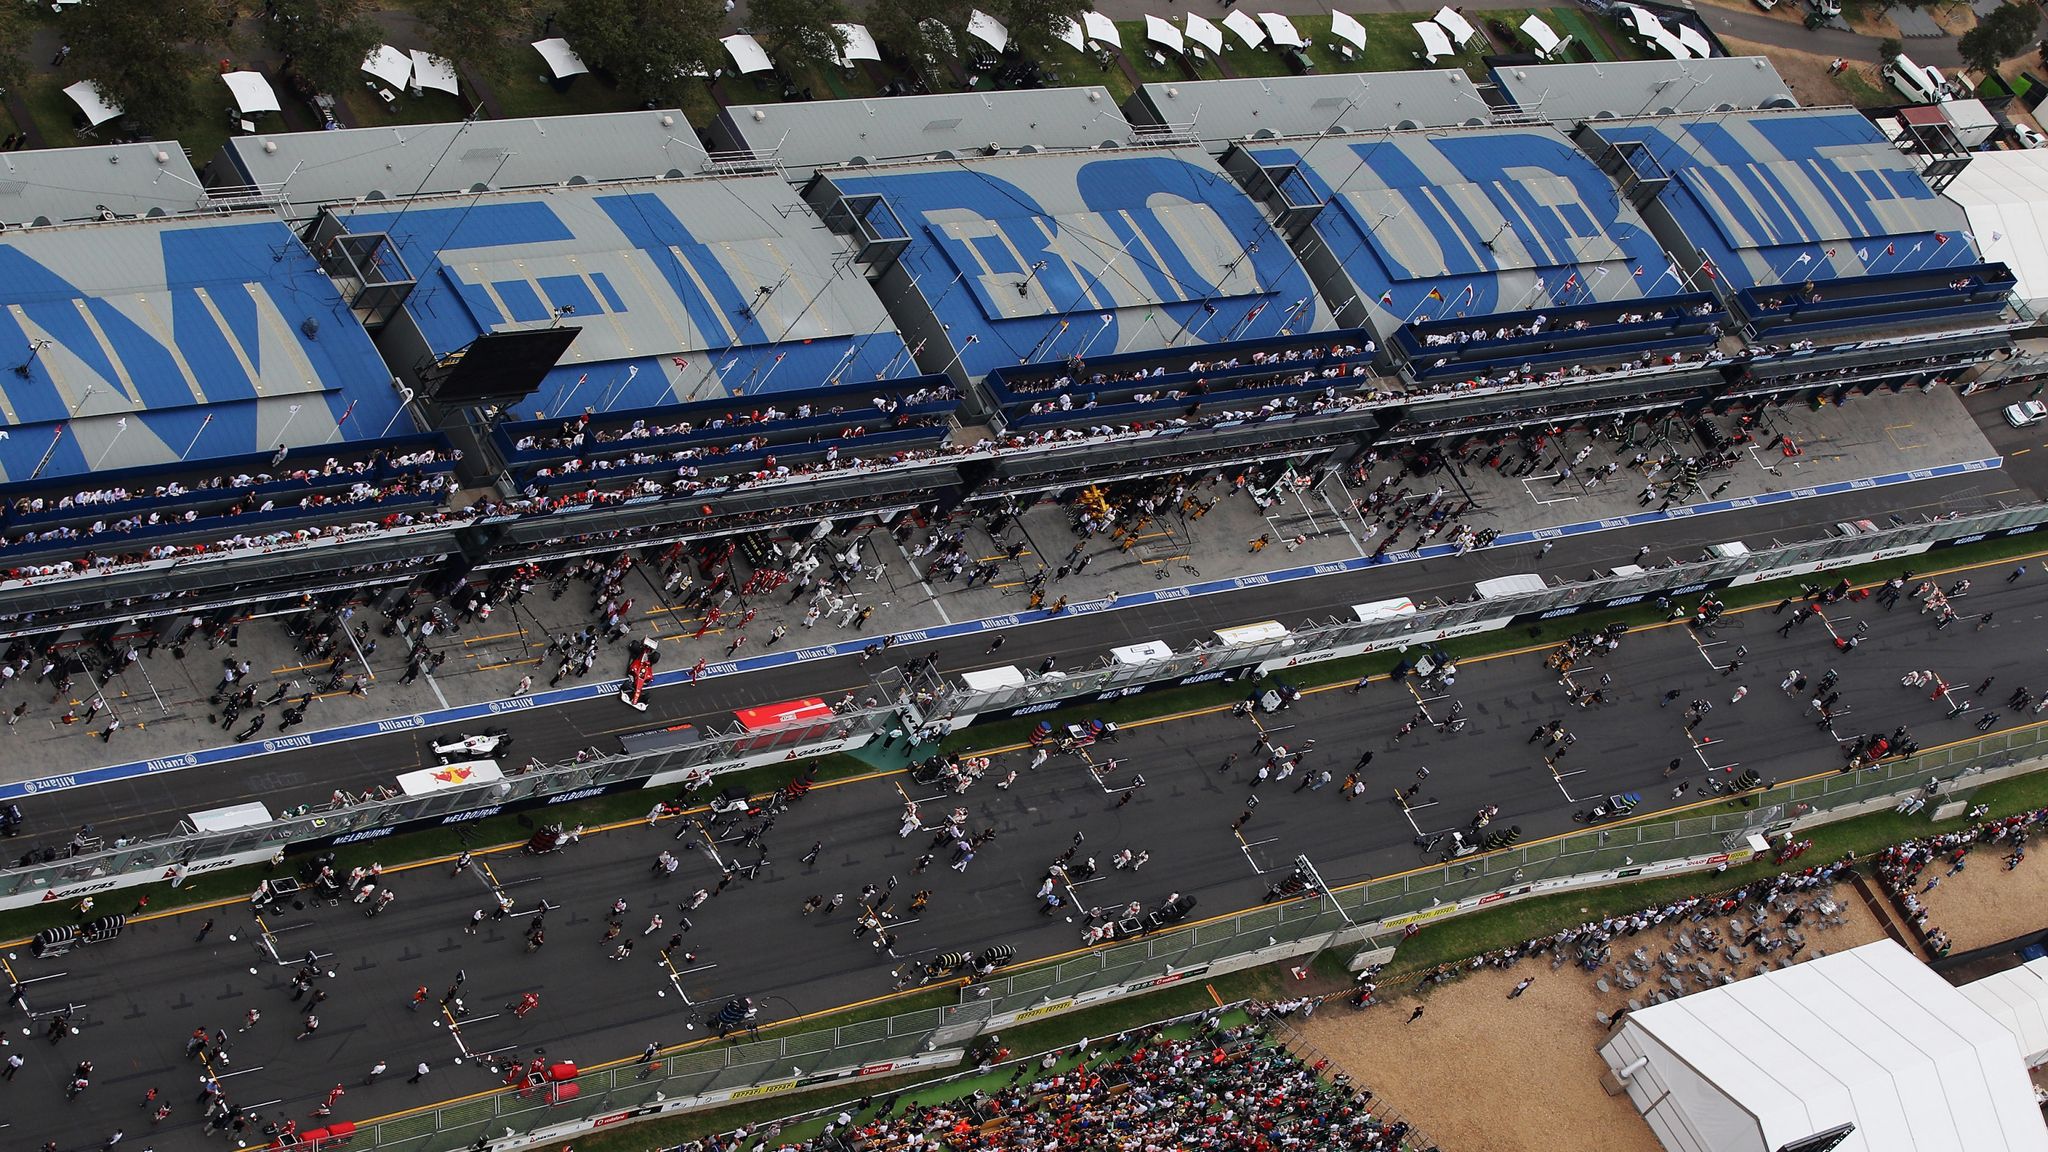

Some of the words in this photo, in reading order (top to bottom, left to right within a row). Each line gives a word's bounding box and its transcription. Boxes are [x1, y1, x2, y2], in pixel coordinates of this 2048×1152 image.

[0, 112, 1975, 483] MELBOURNE
[1600, 519, 1622, 528] Allianz
[1313, 564, 1339, 574] Allianz
[1242, 574, 1269, 585] Allianz
[1154, 589, 1182, 600] Allianz
[1077, 601, 1105, 612] llianz
[980, 618, 1011, 629] Allianz
[897, 630, 929, 642] Allianz
[795, 650, 827, 660] Allianz
[705, 663, 738, 675] Allianz
[1180, 670, 1227, 686] MELBOURNE
[1097, 685, 1145, 700] MELBURNE
[501, 697, 535, 710] Allianz
[1012, 701, 1062, 717] MELBOURNE
[378, 719, 414, 732] Allianz
[276, 735, 312, 748] Allianz
[797, 743, 845, 757] QANTAS
[147, 757, 186, 771] Allianz
[38, 776, 76, 789] Allianz
[548, 786, 606, 804] MELBOURNE
[442, 806, 502, 824] MELBOURNE
[333, 826, 395, 846] MELBOURNE
[187, 858, 236, 873] ANTAS
[57, 880, 117, 898] QANTAS
[1017, 1009, 1042, 1021] Ferrari
[1045, 1001, 1070, 1013] Ferrari
[732, 1088, 761, 1099] Ferrari
[766, 1082, 794, 1093] Ferrari
[604, 1114, 626, 1124] vodafone
